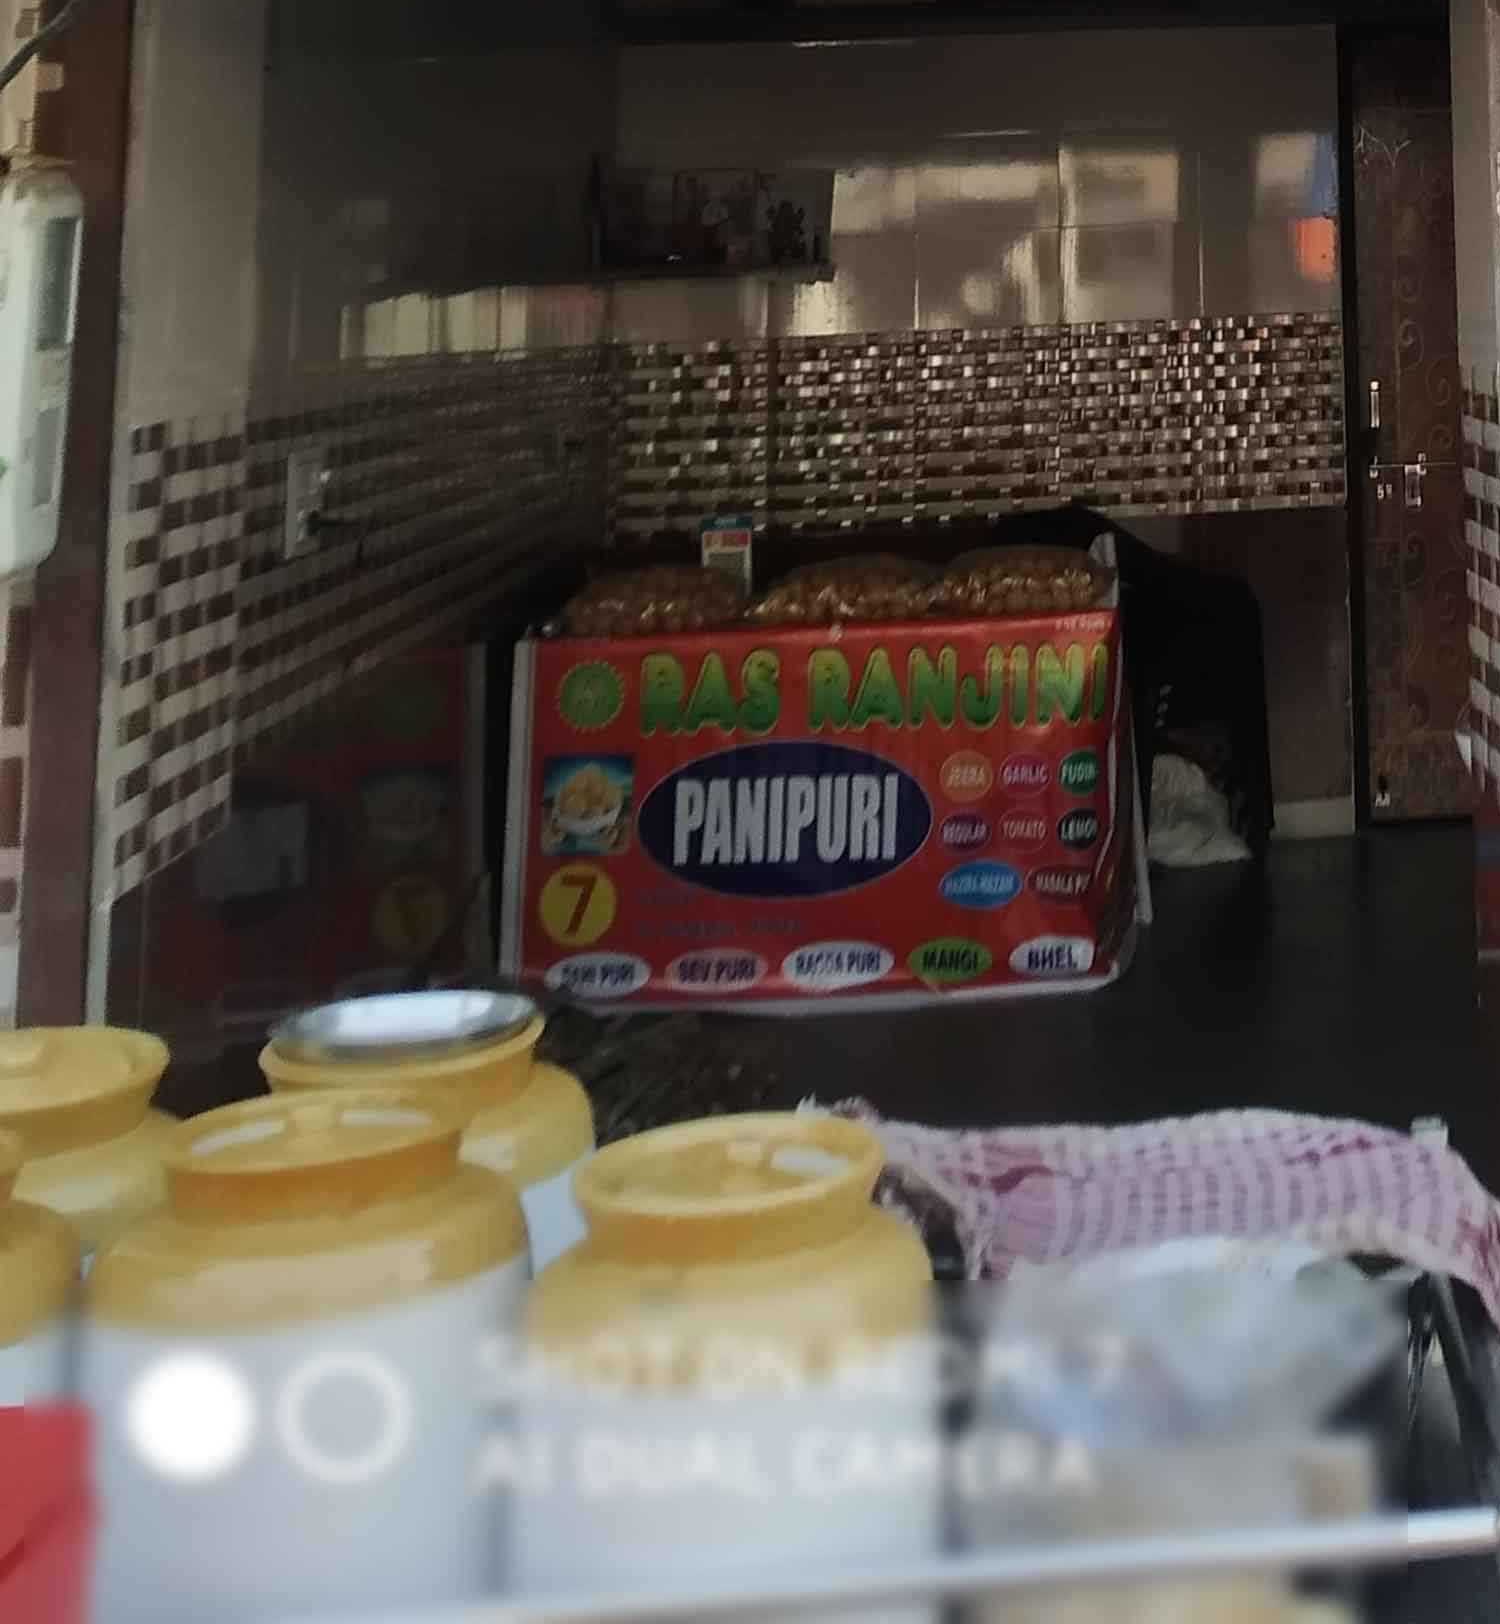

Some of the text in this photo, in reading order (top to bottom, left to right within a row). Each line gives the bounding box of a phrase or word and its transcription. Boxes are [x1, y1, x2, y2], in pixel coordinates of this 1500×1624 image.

[641, 648, 782, 737] RAS
[807, 642, 1109, 731] RANJINI
[673, 773, 899, 866] PANIPURI
[559, 875, 599, 935] 7
[921, 947, 978, 971] MANGI
[1028, 943, 1079, 969] BHEL
